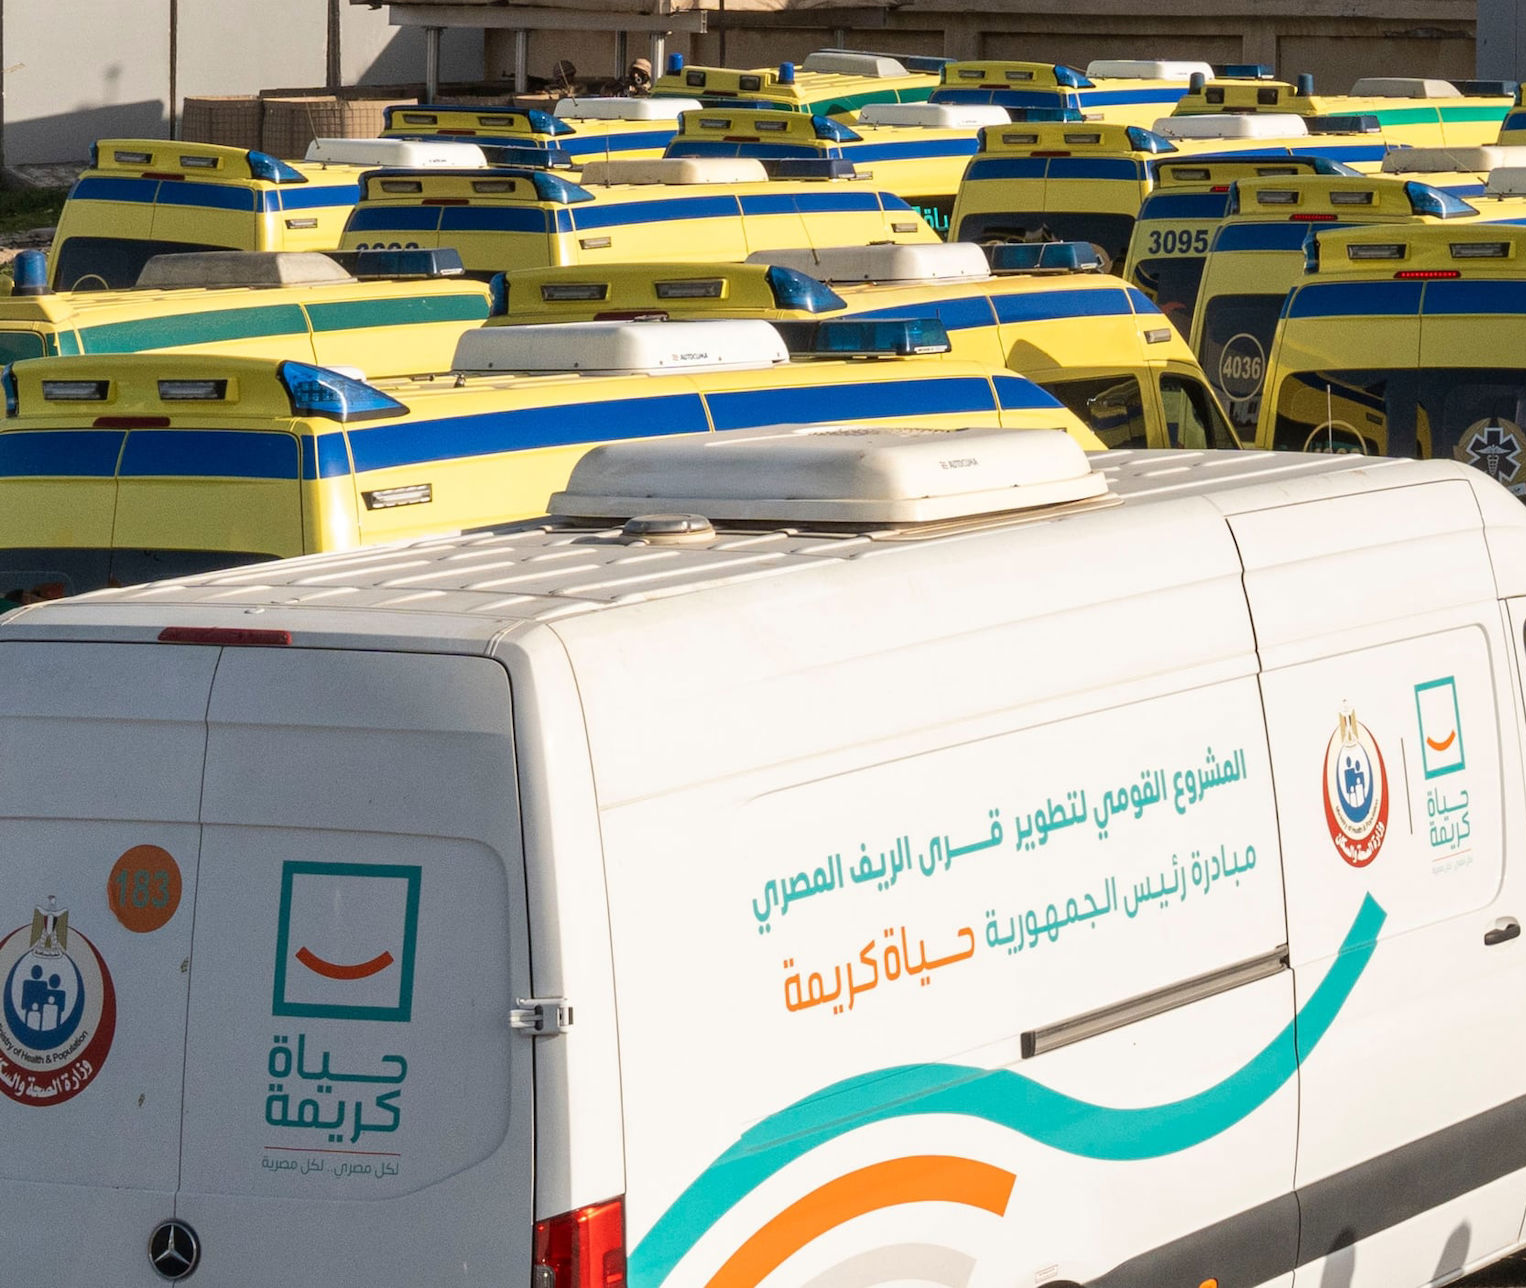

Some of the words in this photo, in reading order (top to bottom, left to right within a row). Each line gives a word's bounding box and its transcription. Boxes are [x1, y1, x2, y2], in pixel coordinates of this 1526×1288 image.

[1148, 230, 1209, 254] 3095
[1223, 356, 1261, 379] 4036
[1094, 769, 1167, 840] القومي
[1172, 746, 1247, 815] المشروع
[1427, 787, 1469, 821] حياة
[919, 808, 1003, 877] قرى
[1016, 789, 1087, 851] لتطوير
[1430, 811, 1470, 850] كريمة
[115, 868, 169, 908] 183
[850, 835, 912, 892] الريف
[1124, 853, 1187, 918] رئيس
[1191, 844, 1256, 895] مبادرة
[752, 854, 844, 935] المصري
[986, 876, 1117, 955] الجمهورية
[783, 940, 879, 1015] كريمة
[884, 925, 975, 987] حياة
[21, 1051, 45, 1064] Health
[53, 1031, 88, 1061] Population
[268, 1034, 408, 1093] حياة
[26, 1077, 62, 1097] الصحة
[64, 1060, 93, 1091] وزارة
[265, 1084, 401, 1143] كريمة
[262, 1156, 297, 1172] مصرية
[300, 1159, 324, 1174] لكل
[375, 1163, 398, 1178] لكل
